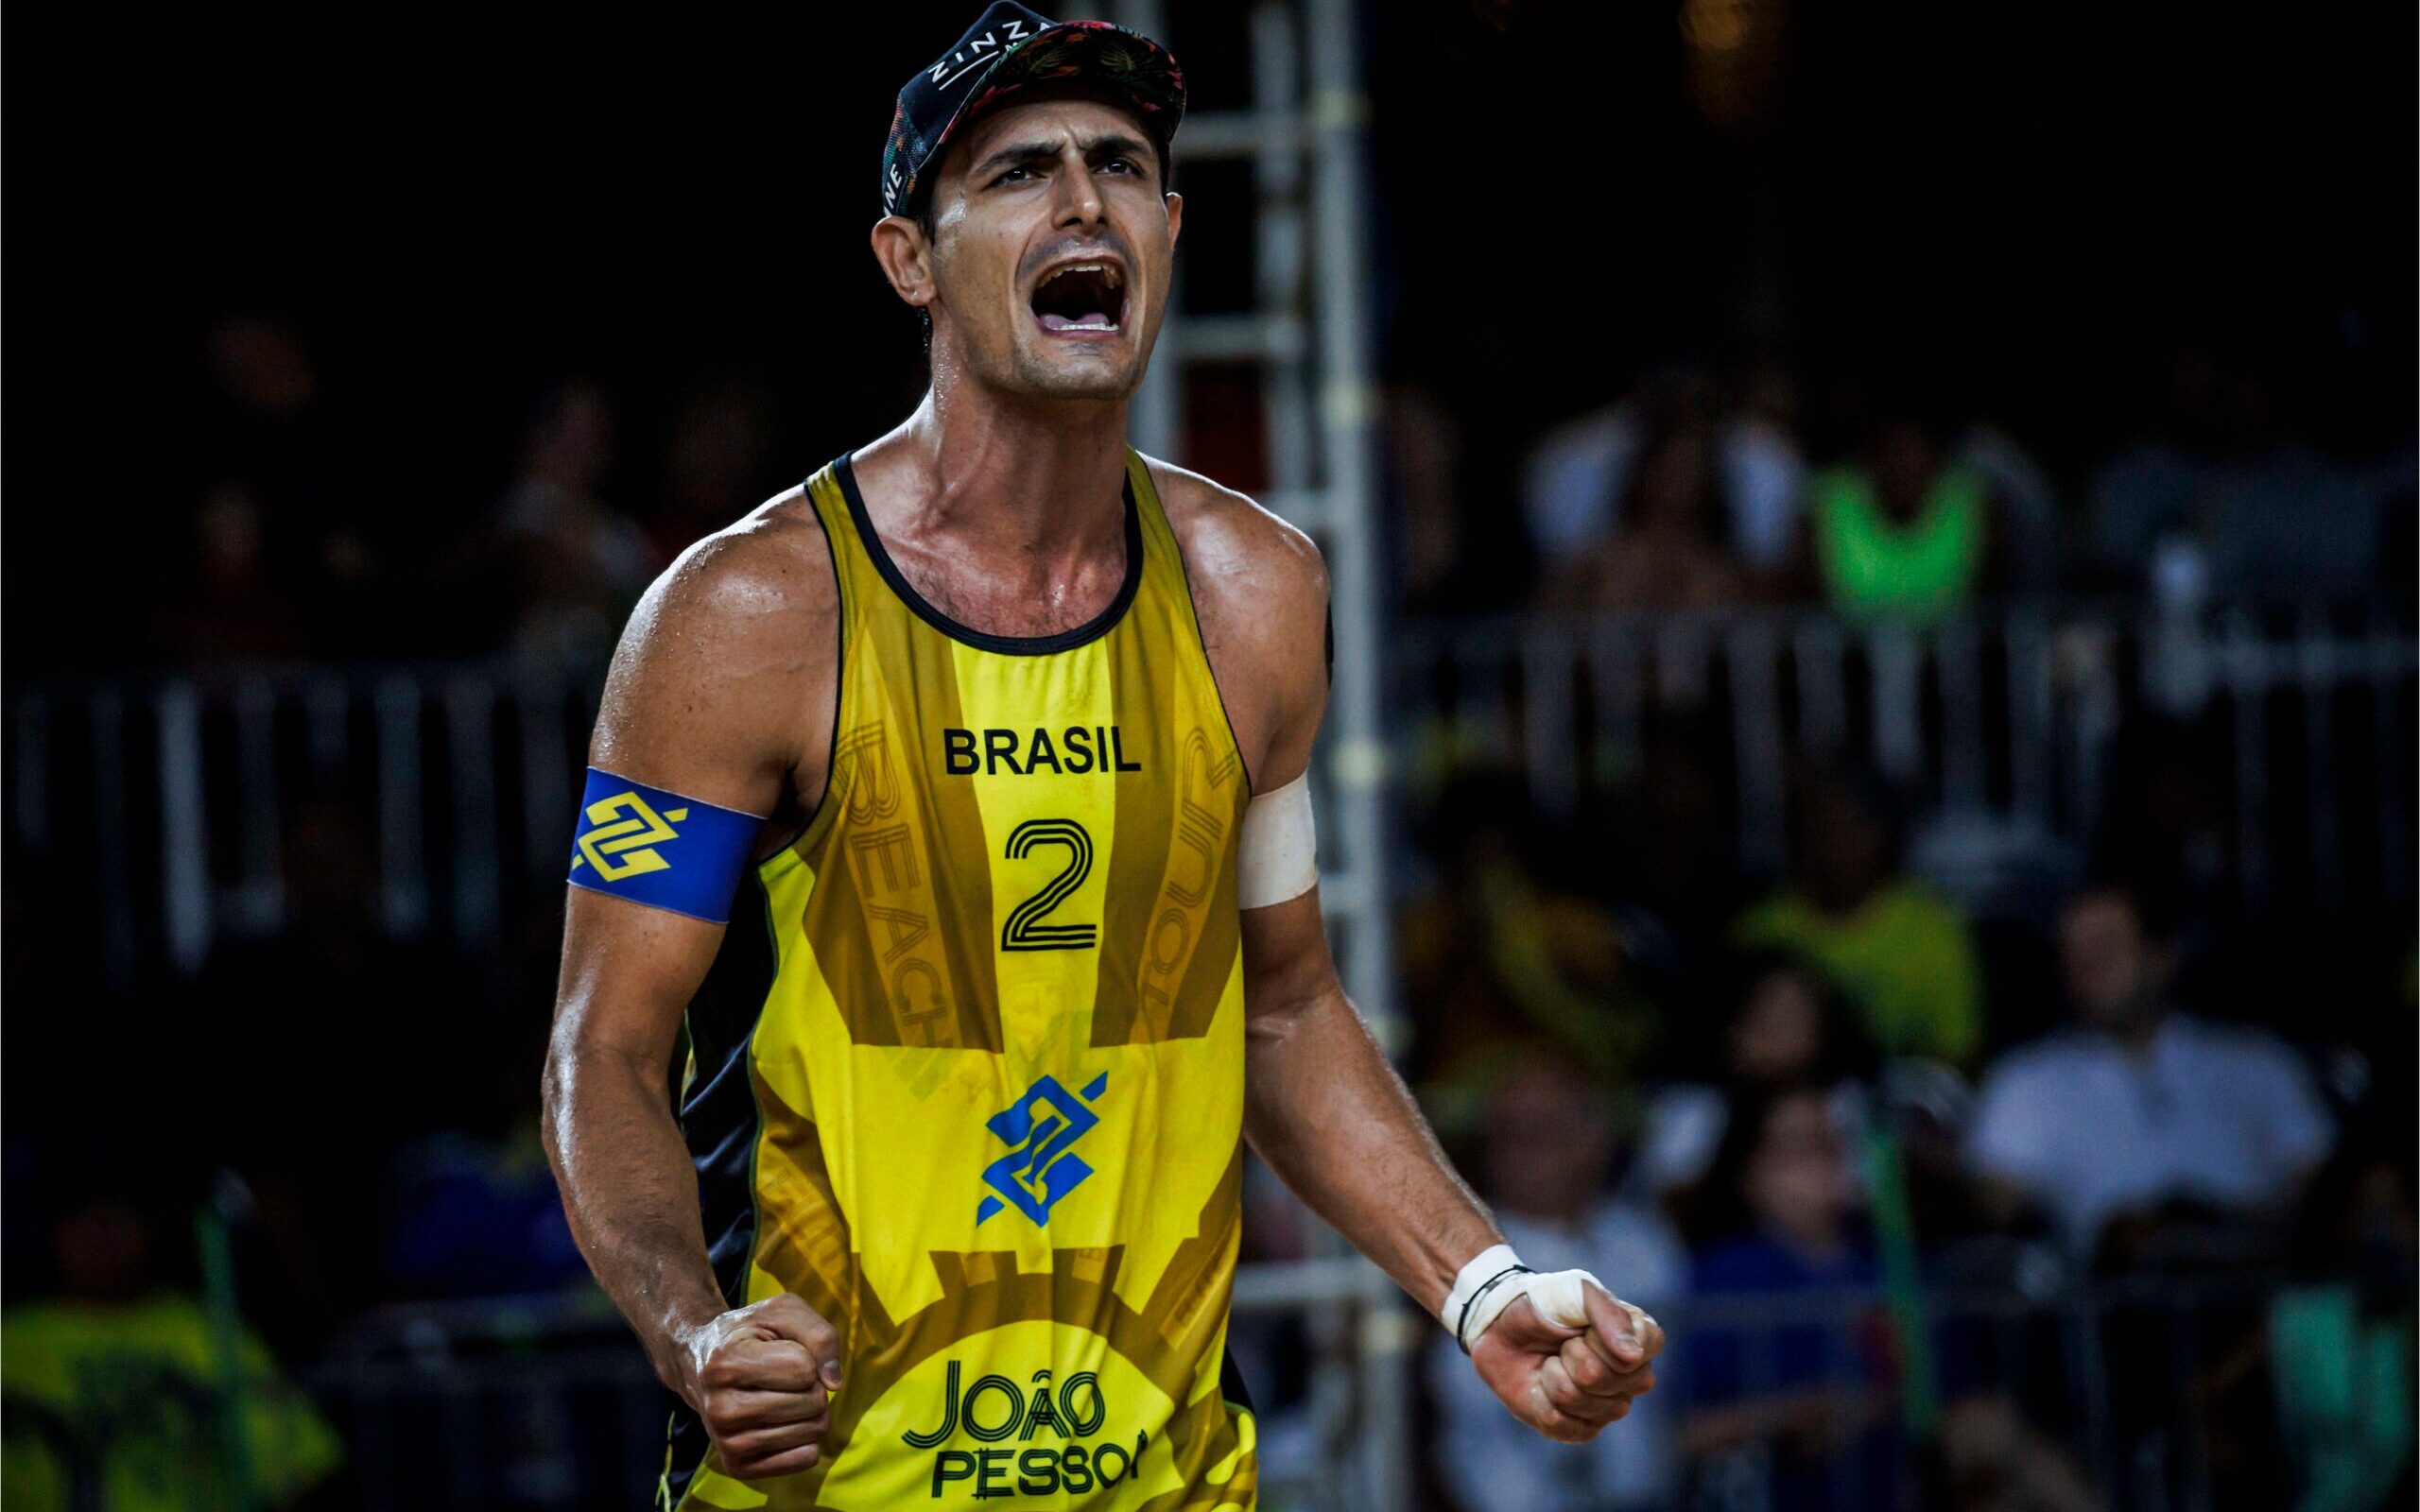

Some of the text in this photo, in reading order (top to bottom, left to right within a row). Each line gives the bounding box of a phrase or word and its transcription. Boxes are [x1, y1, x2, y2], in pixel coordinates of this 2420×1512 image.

[943, 726, 1142, 775] BRASIL
[1001, 818, 1097, 952] 2
[901, 1360, 1105, 1449] JOÃO
